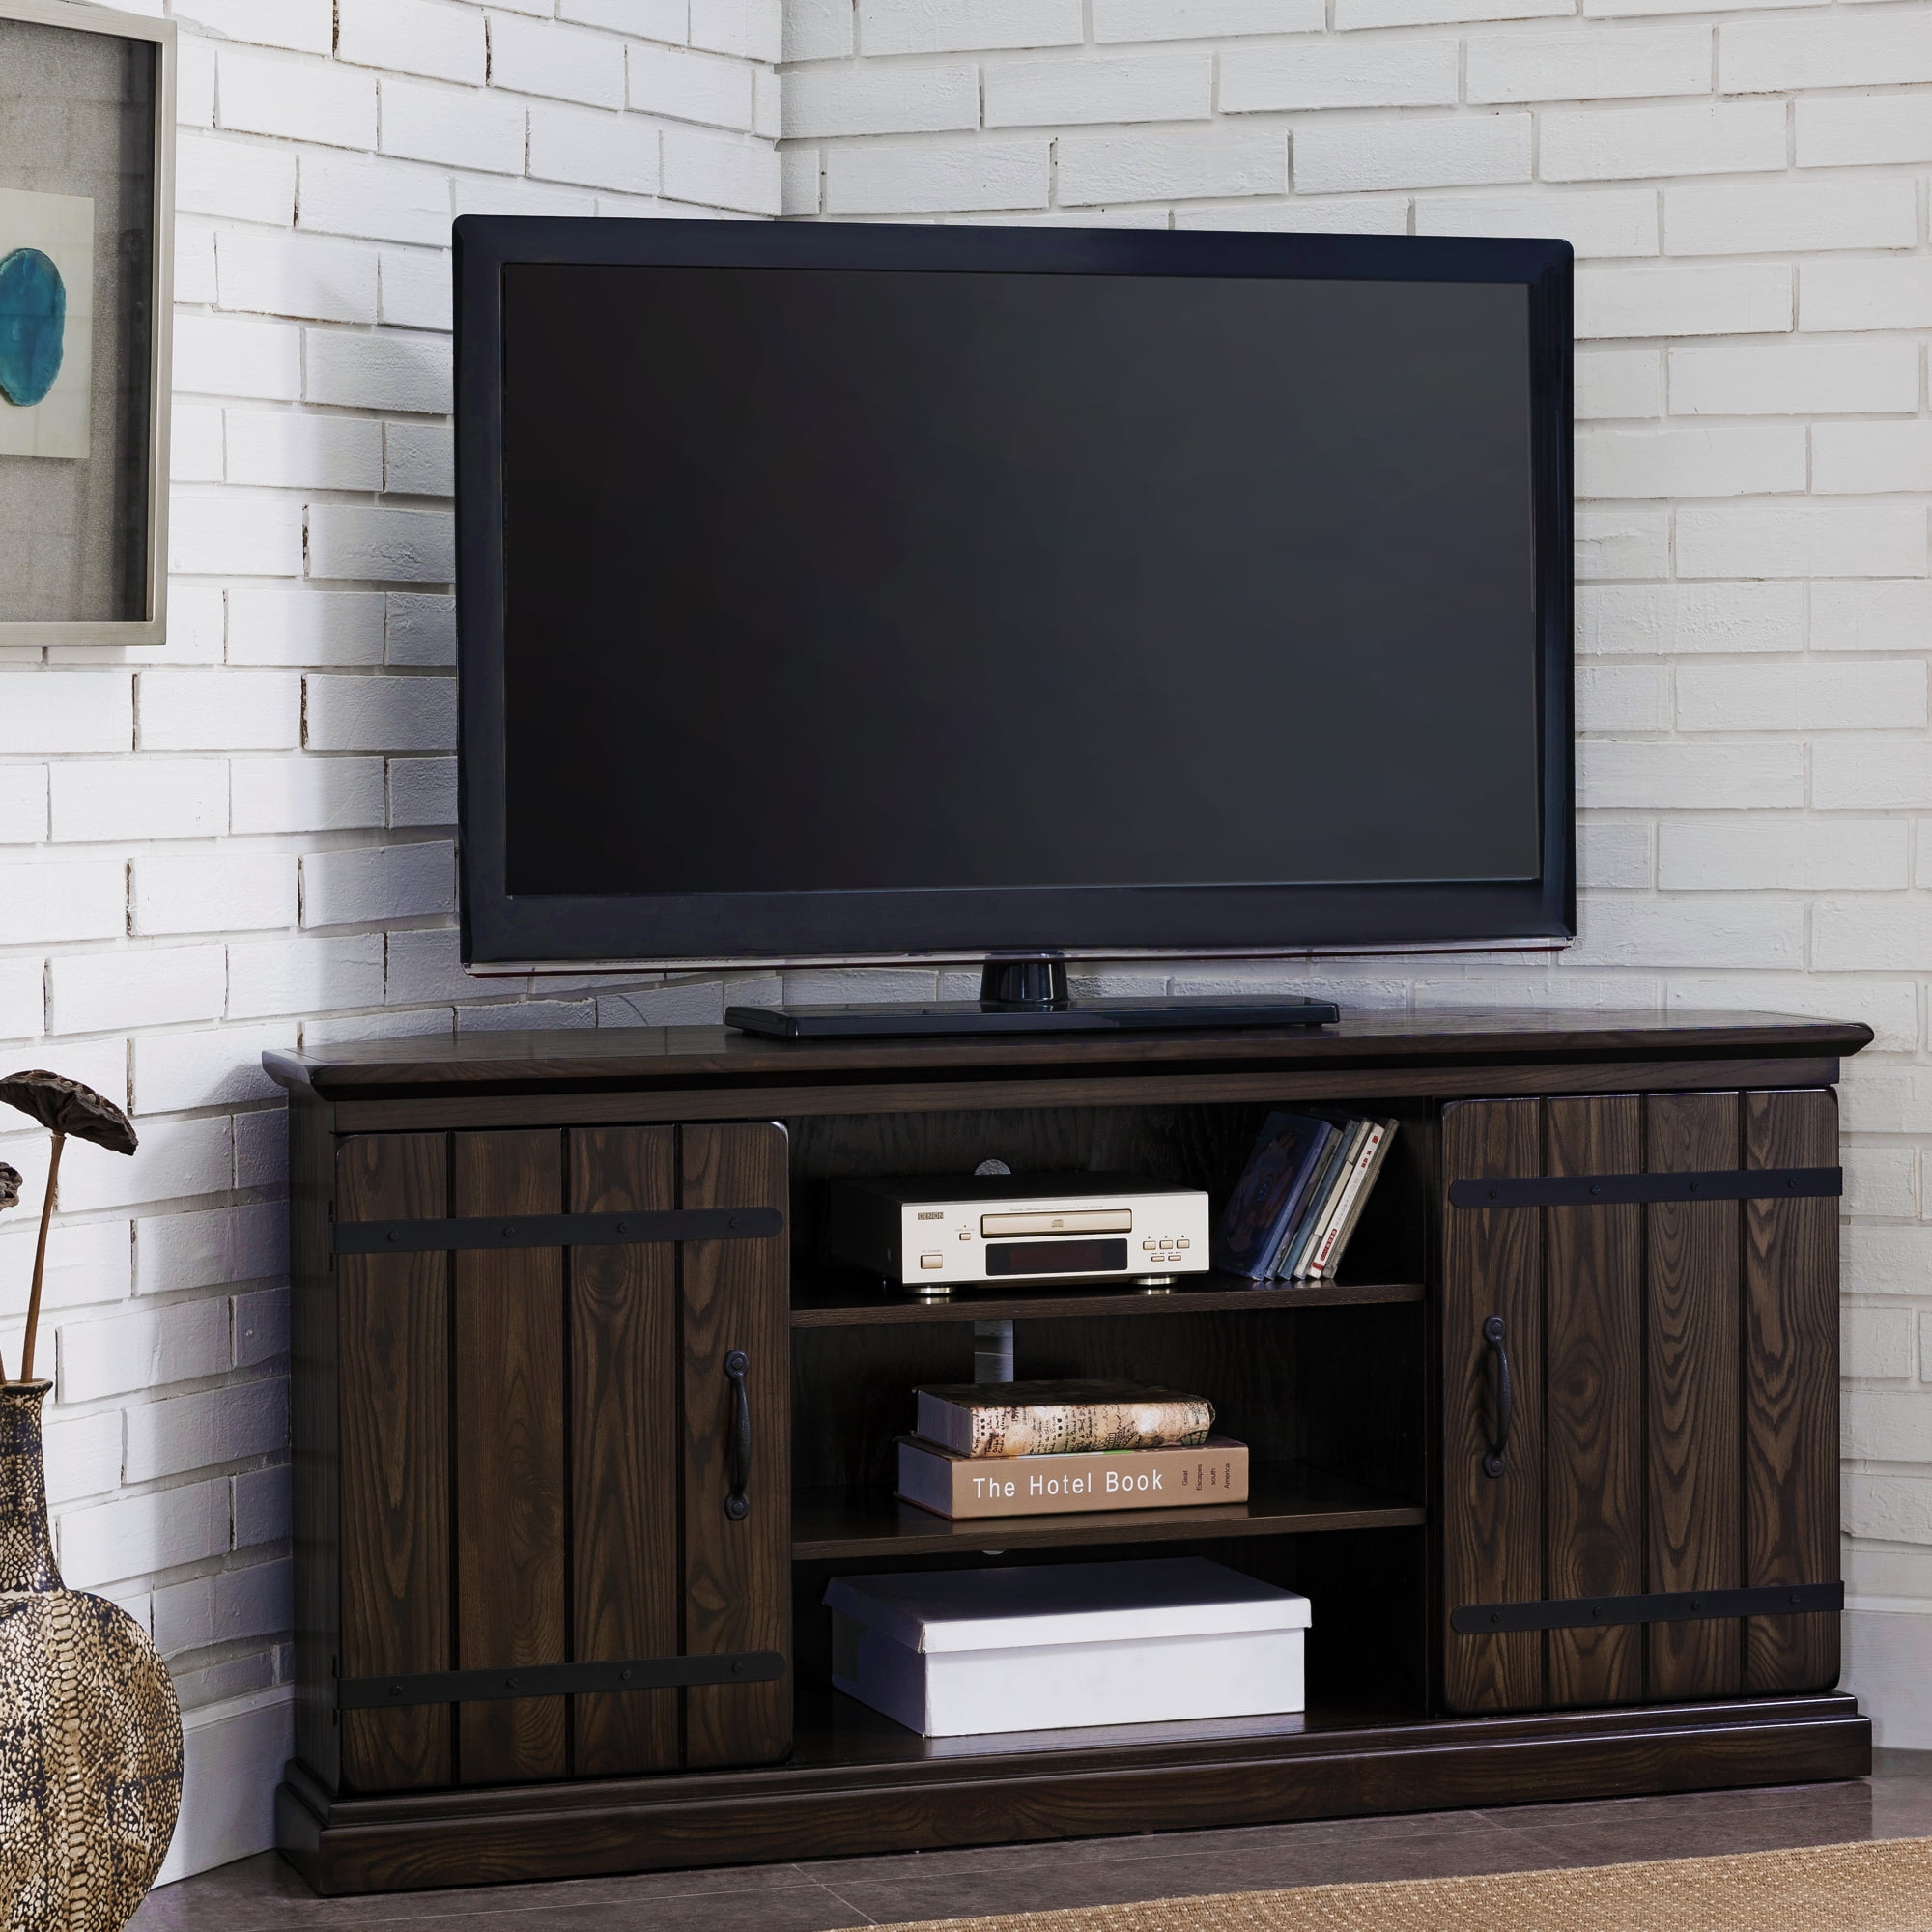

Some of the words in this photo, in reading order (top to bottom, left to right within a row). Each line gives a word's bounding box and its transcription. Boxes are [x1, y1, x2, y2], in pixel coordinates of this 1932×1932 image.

[972, 1477, 1017, 1499] The
[1029, 1472, 1092, 1496] Hotel
[1105, 1468, 1164, 1492] Book
[1195, 1463, 1204, 1492] Escapes
